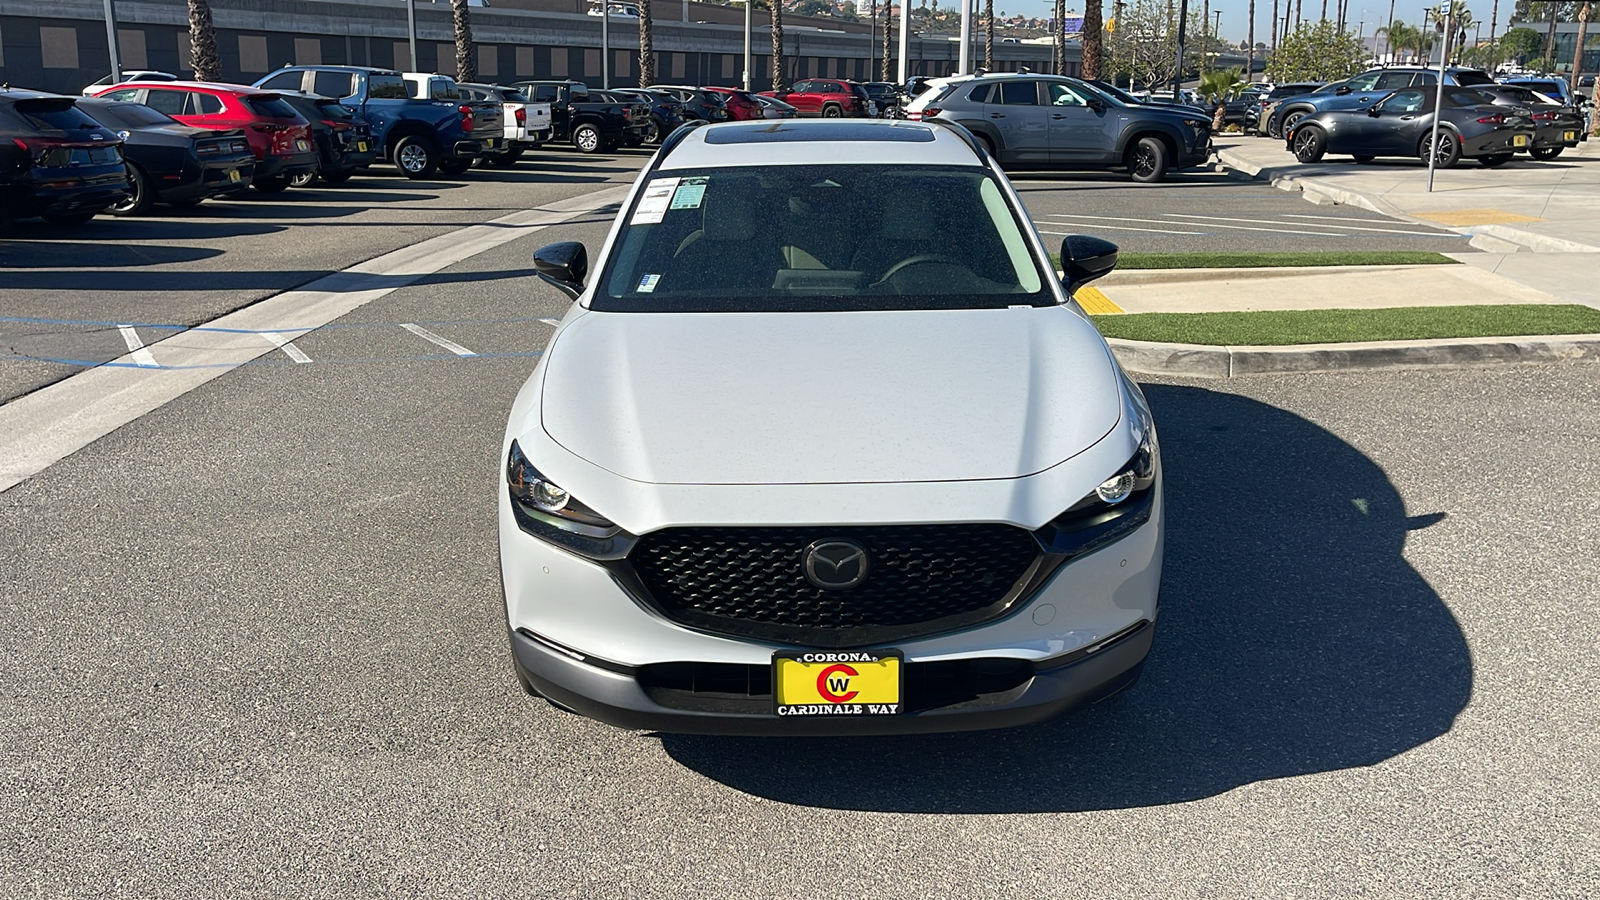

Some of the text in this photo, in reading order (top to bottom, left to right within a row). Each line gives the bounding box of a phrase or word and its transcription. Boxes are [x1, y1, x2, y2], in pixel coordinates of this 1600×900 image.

[803, 653, 872, 662] CORONA
[816, 663, 860, 704] C
[829, 676, 850, 693] W
[777, 704, 898, 716] CARDINALE WAY
